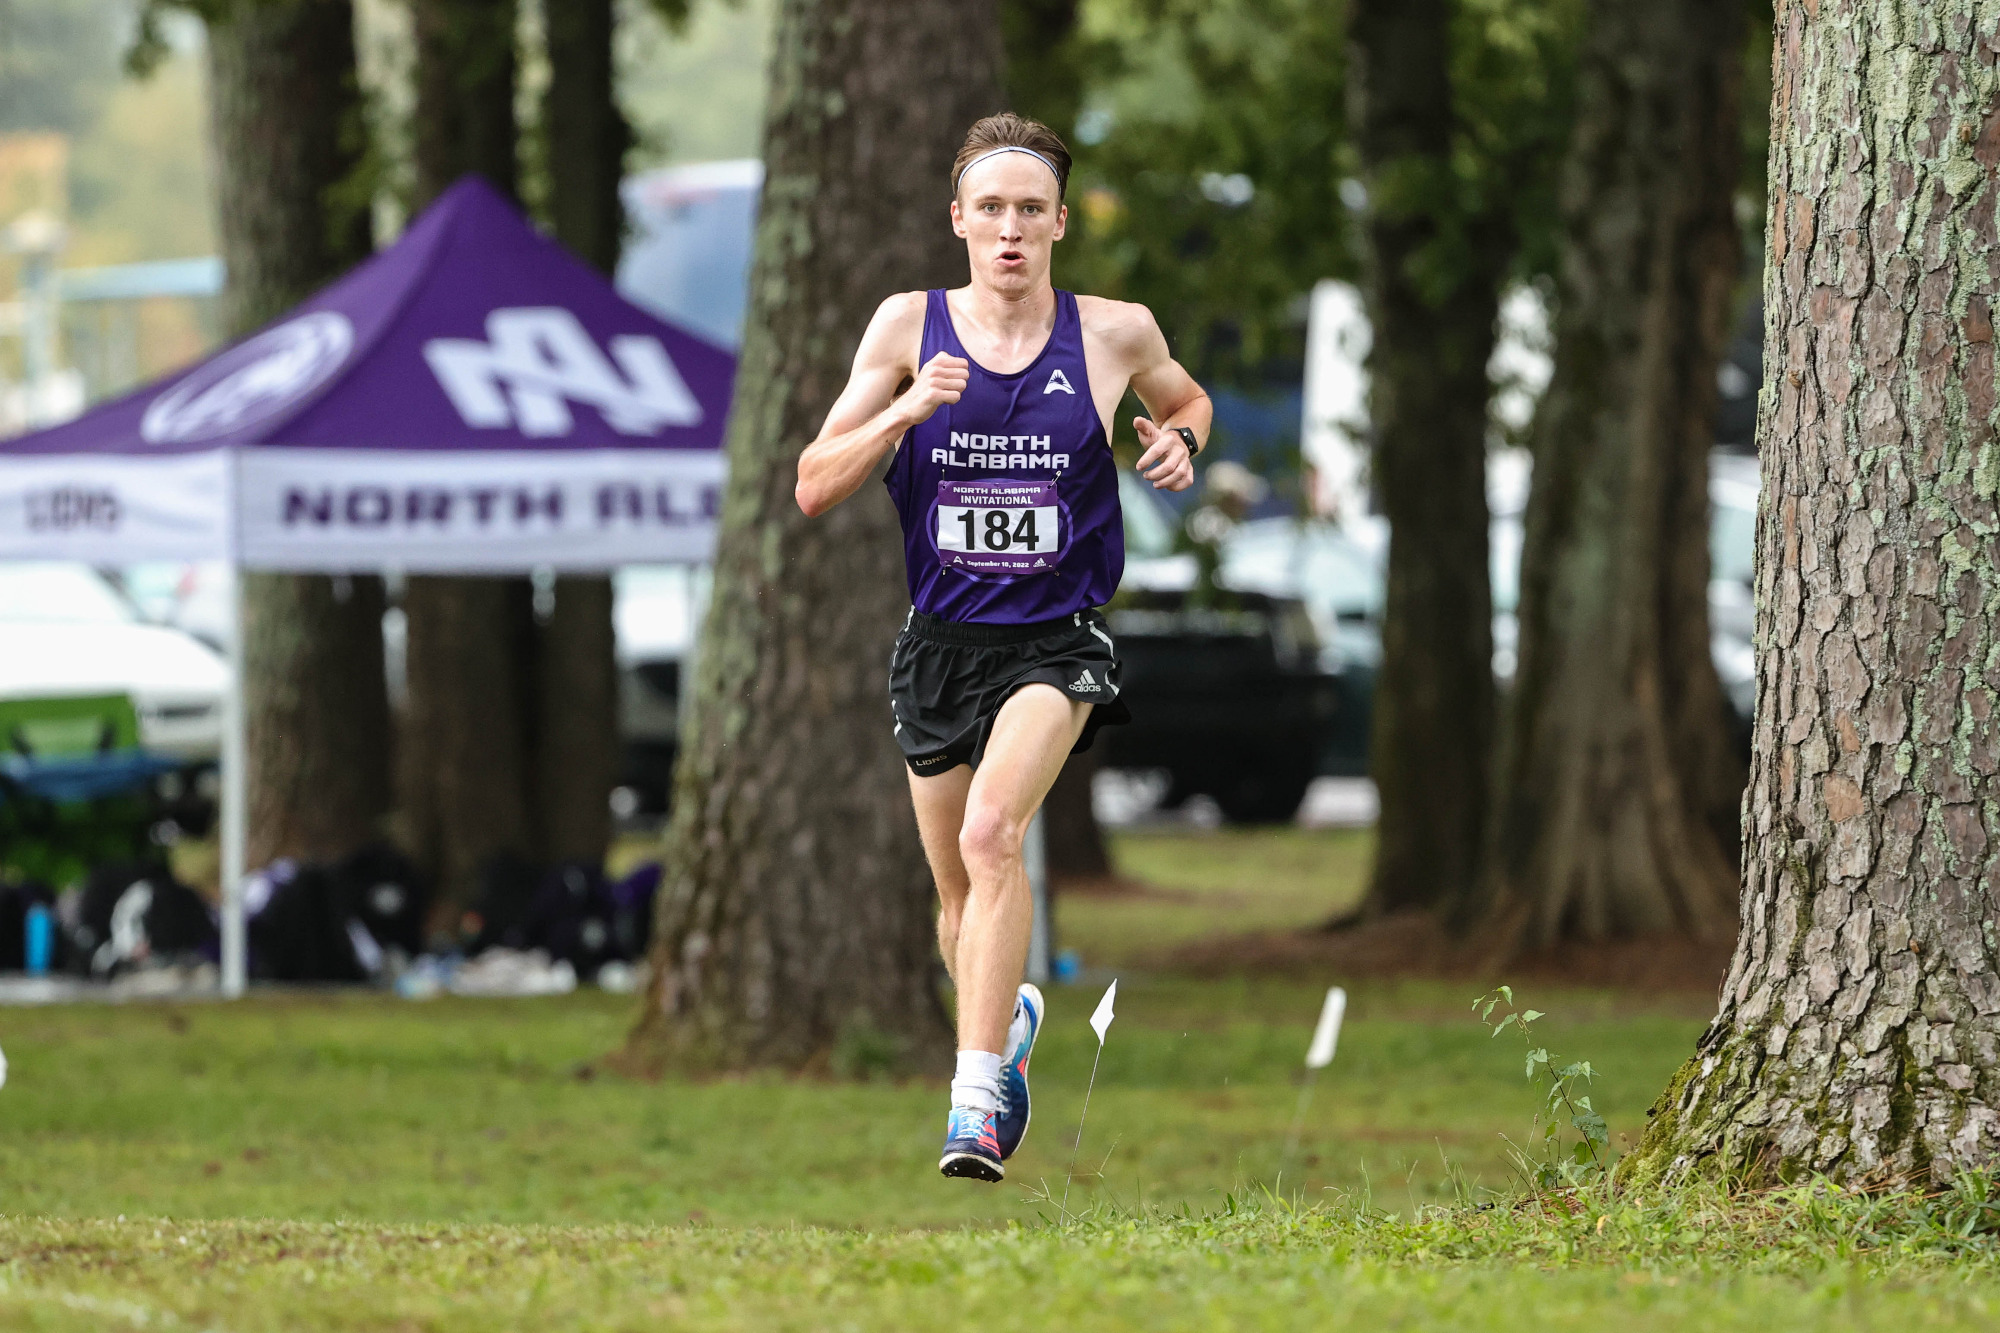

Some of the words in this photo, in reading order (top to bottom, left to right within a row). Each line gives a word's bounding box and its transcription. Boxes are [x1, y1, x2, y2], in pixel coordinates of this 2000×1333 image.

[950, 431, 1051, 451] NORTH
[931, 448, 1070, 470] ALABAMA
[953, 486, 988, 495] NORTH
[991, 486, 1041, 495] ALABAMA
[280, 482, 564, 530] NORTH
[960, 495, 1034, 505] INVITATIONAL
[957, 509, 1040, 552] 184
[966, 560, 1000, 568] September
[1068, 683, 1102, 693] adidas
[915, 754, 948, 767] LIONS
